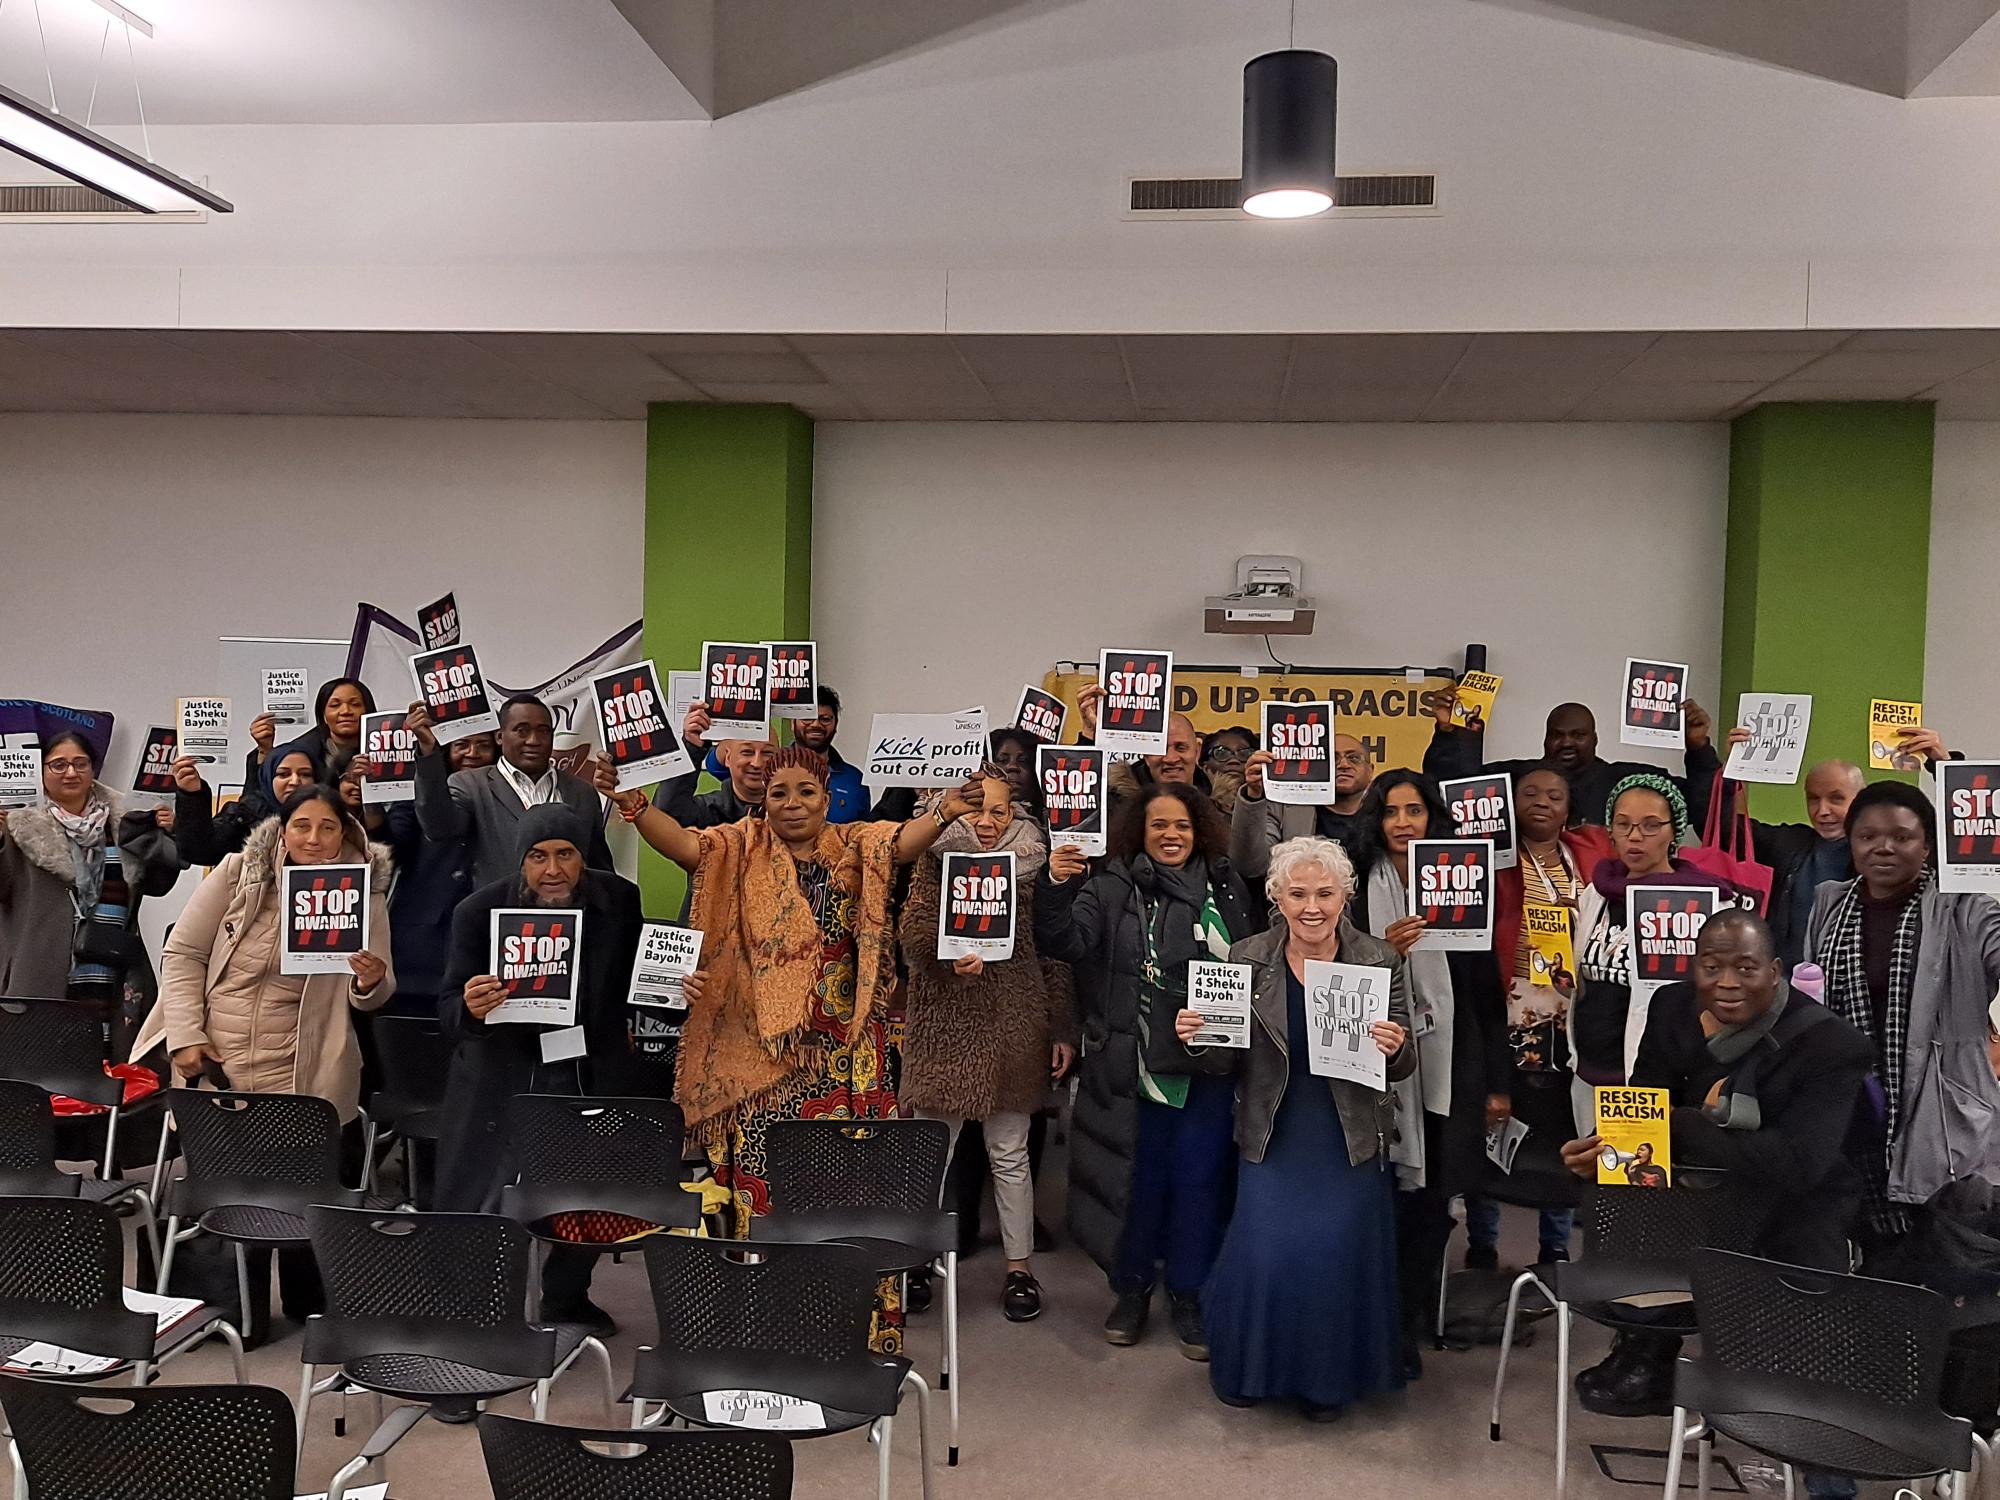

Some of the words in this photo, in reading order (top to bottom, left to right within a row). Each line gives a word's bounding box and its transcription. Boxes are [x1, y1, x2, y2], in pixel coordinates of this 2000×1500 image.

[424, 608, 456, 640] STOP
[711, 663, 764, 687] STOP
[770, 659, 810, 678] STOP
[423, 663, 475, 694] STOP
[1109, 671, 1163, 696] STOP
[1461, 680, 1497, 694] RACISM
[1466, 673, 1498, 685] RESIST
[428, 683, 481, 707] RWANDA
[710, 685, 762, 701] RWANDA
[1631, 677, 1679, 701] STOP
[184, 700, 224, 709] Justice
[603, 689, 654, 726] STOP
[1108, 694, 1161, 711] RWANDA
[1210, 686, 1260, 713] UP
[1329, 688, 1438, 718] RACIS
[1873, 702, 1915, 716] RESIST
[41, 703, 97, 729] SCOTLAND
[194, 710, 228, 718] Sheku
[1022, 702, 1061, 731] STOP
[1872, 713, 1918, 726] RACISM
[184, 719, 218, 729] Bayoh
[607, 715, 665, 743] RWANDA
[1019, 719, 1057, 743] RWANDA
[1743, 712, 1801, 736] STOP
[1271, 723, 1326, 747] STOP
[1741, 735, 1798, 749] WANDA
[0, 752, 31, 761] ustice
[147, 743, 178, 765] ST
[874, 736, 928, 756] Kick
[931, 740, 981, 760] profit
[1271, 746, 1326, 761] RWANDA
[0, 770, 27, 780] ayoh
[870, 762, 903, 775] out
[908, 763, 929, 776] of
[933, 766, 972, 779] care
[1044, 769, 1098, 795] STOP
[1046, 794, 1097, 810] RWANDA
[1451, 796, 1505, 822] STOP
[1420, 864, 1484, 891] STOP
[952, 875, 1008, 901] STOP
[294, 889, 360, 916] STOP
[1421, 890, 1484, 906] RWANDA
[951, 899, 1008, 916] RWANDA
[1527, 908, 1562, 922] RESIST
[294, 914, 359, 931] RWANDA
[1529, 919, 1567, 934] RACISM
[1639, 911, 1707, 939] STOP
[648, 928, 692, 943] Justice
[503, 935, 571, 963] STOP
[646, 940, 654, 949] 4
[656, 940, 695, 955] Sheku
[1641, 939, 1697, 956] RWAND
[644, 950, 682, 964] Bayoh
[503, 960, 568, 980] RWANDA
[1195, 965, 1240, 979] Justice
[1195, 977, 1203, 987] 4
[1206, 977, 1245, 990] Sheku
[1195, 988, 1234, 1002] Bayoh
[1312, 985, 1380, 1022] STOP
[1314, 1013, 1374, 1039] RWAND
[1600, 1091, 1659, 1106] RESIST
[1600, 1105, 1665, 1121] RACISM
